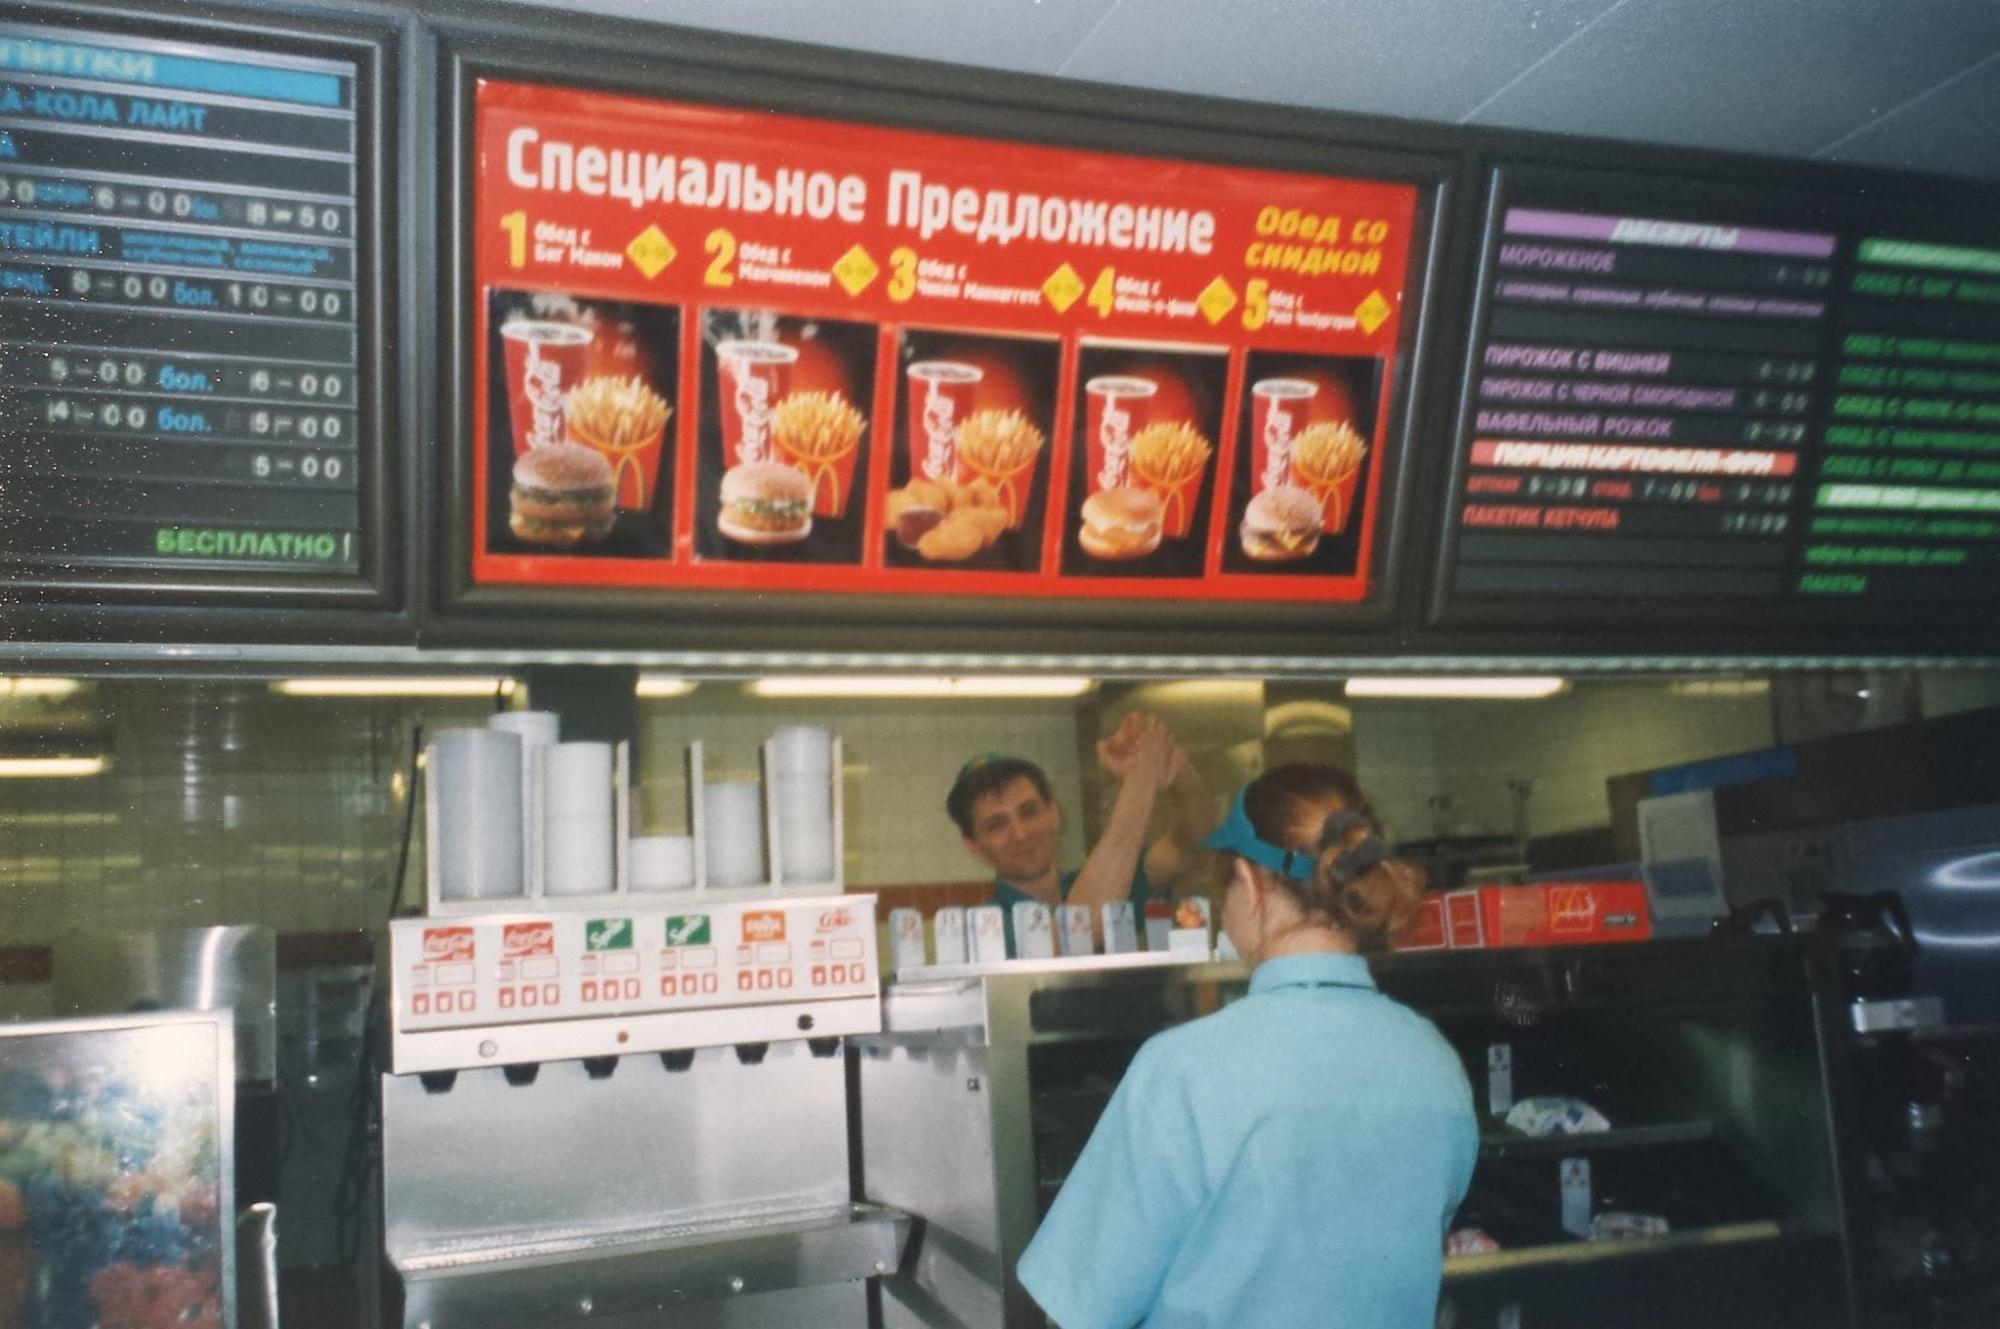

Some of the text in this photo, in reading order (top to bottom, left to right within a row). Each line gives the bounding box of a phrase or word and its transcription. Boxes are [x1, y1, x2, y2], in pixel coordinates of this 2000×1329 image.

[128, 99, 207, 131] ЛАЙТ
[507, 127, 1215, 256] Специальное Предложение
[500, 210, 527, 269] 1
[1256, 205, 1389, 244] Обед со
[703, 227, 736, 288] 2
[1244, 241, 1382, 276] скидкой
[1499, 244, 1616, 273] МОРОЖЕНОЕ
[887, 246, 918, 304] 3
[1087, 265, 1116, 319] 4
[1241, 278, 1269, 331] 5
[1484, 345, 1573, 371] ПИРОЖОК
[1577, 349, 1592, 371] С
[159, 365, 214, 393] бол.
[1556, 380, 1569, 401] С
[157, 406, 213, 432] бол.
[1476, 408, 1675, 439] ВАФЕЛЬНЫЙ РОЖОК
[156, 528, 336, 560] БЕСПЛАТНО
